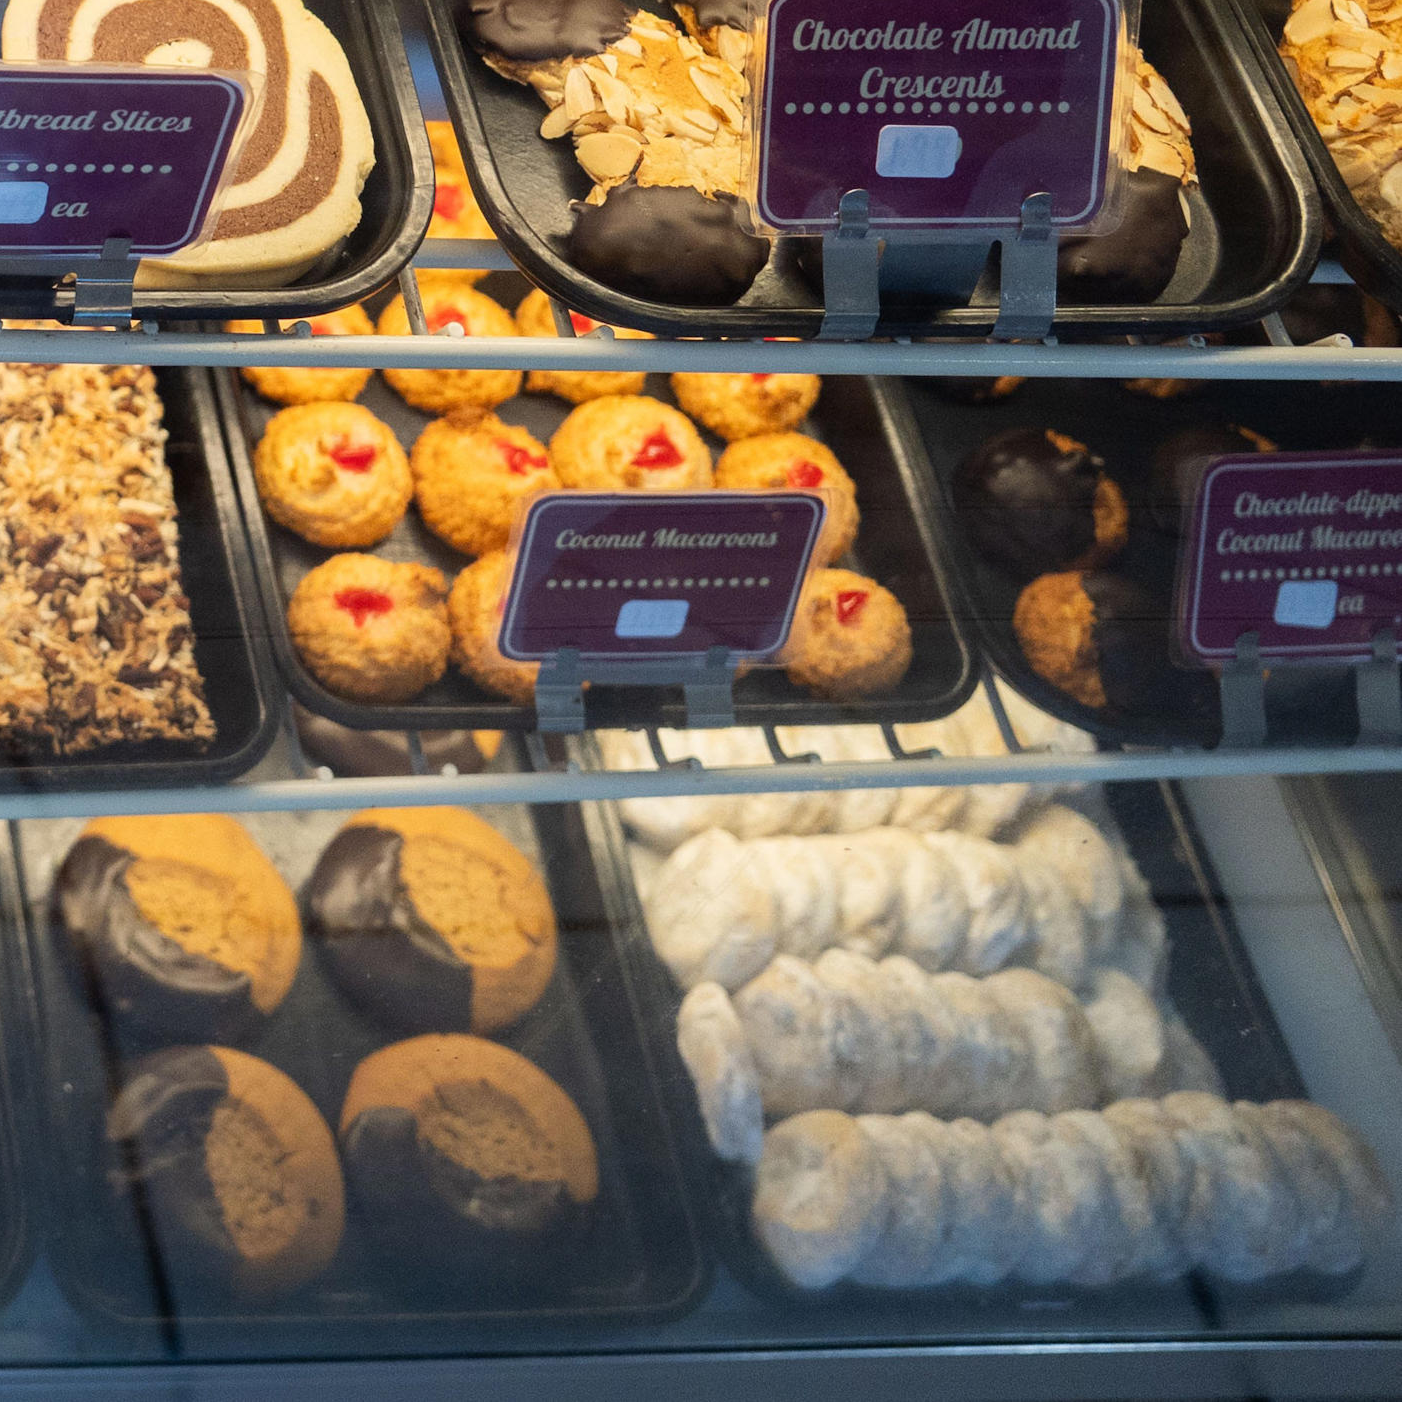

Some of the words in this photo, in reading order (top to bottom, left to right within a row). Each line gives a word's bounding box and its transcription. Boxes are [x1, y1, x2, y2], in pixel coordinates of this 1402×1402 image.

[792, 18, 944, 52] Chocolate
[950, 17, 1082, 54] Almond
[859, 66, 1005, 100] Crescents
[102, 108, 194, 133] Slices
[51, 198, 90, 219] ea
[555, 528, 646, 549] Coconut
[650, 527, 779, 548] Macaroons
[1216, 527, 1305, 555] Coconut
[1337, 594, 1365, 615] ea
